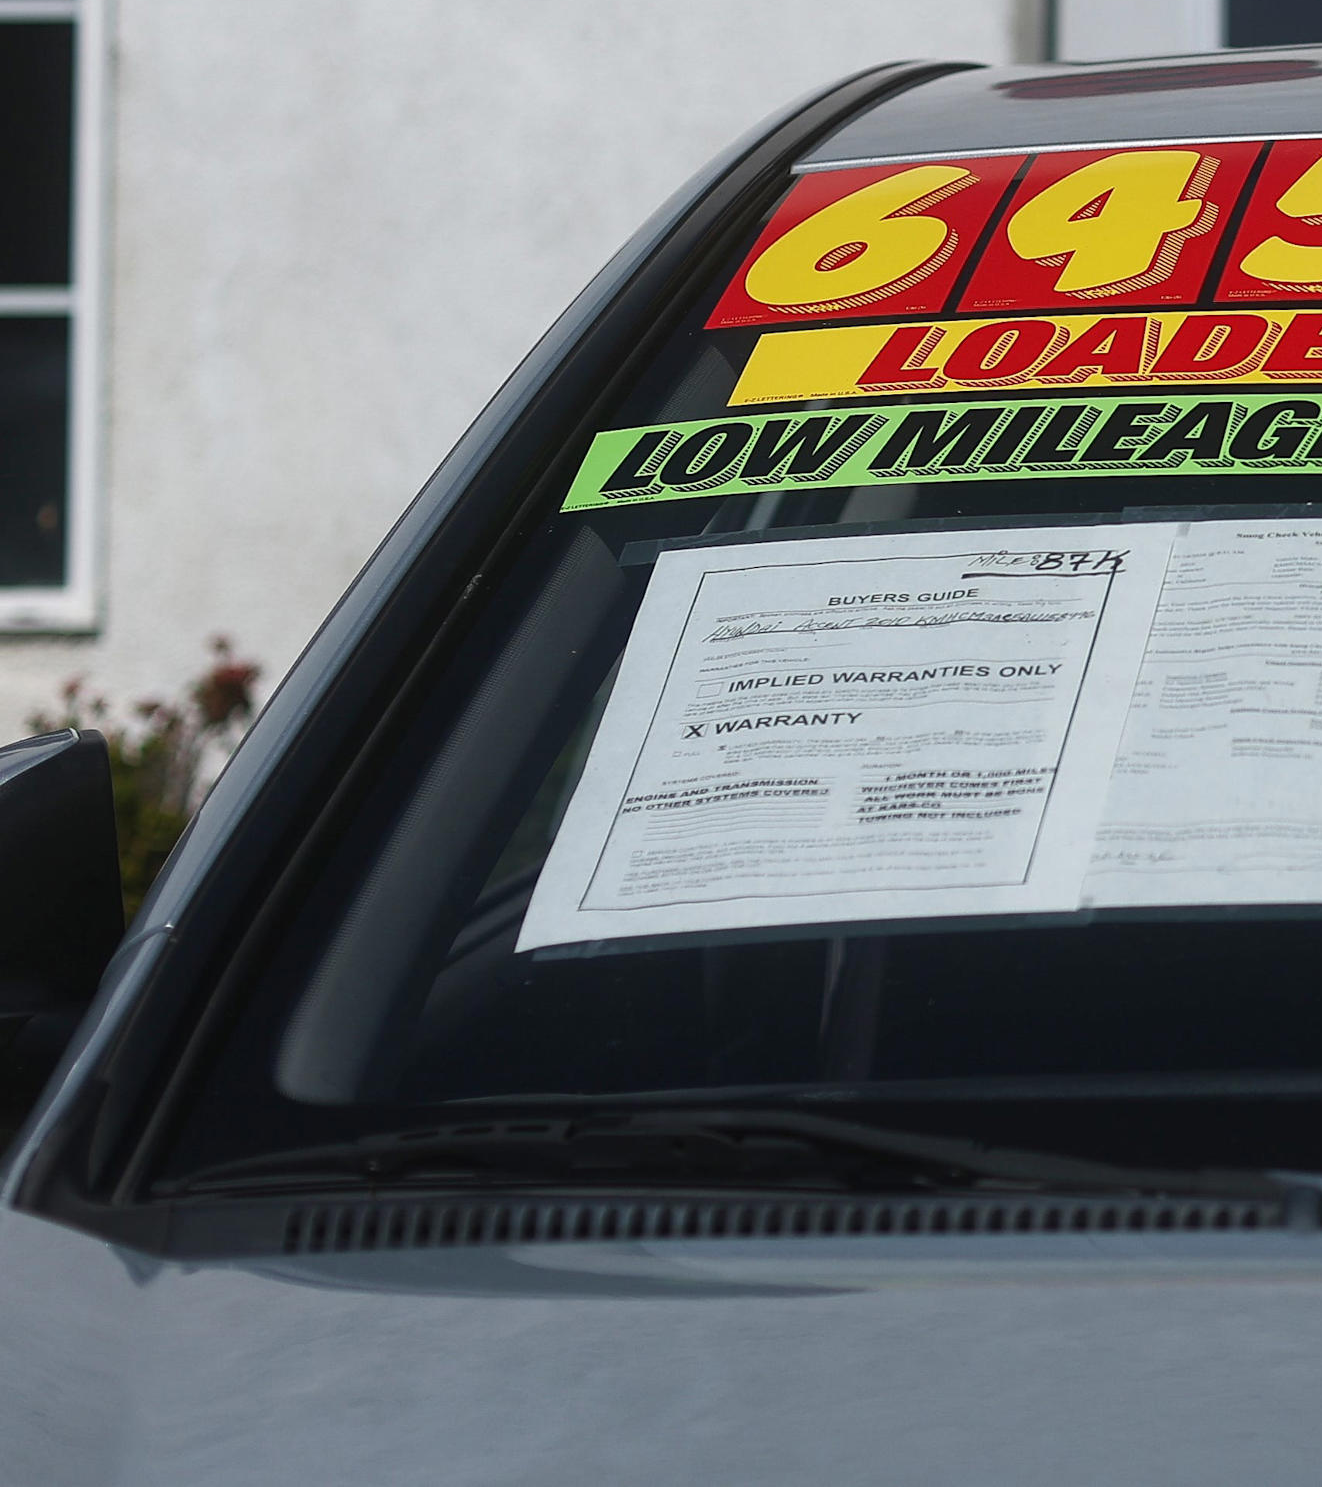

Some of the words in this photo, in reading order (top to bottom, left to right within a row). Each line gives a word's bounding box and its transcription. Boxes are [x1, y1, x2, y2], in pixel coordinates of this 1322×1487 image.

[597, 415, 888, 502] LOW
[1236, 532, 1264, 540] Smog
[1267, 530, 1298, 539] Check
[1035, 549, 1131, 572] 87K
[828, 593, 910, 606] BUYERS
[917, 588, 980, 602] GUIDE
[728, 673, 825, 693] IMPLIED
[832, 665, 991, 684] WARRANTIES
[998, 664, 1064, 678] ONLY
[683, 724, 705, 739] X
[715, 712, 863, 735] WARRANTY
[861, 781, 945, 793] WHICHEVER
[949, 780, 999, 789] COMES
[896, 771, 946, 781] MONTH
[622, 805, 642, 814] NO
[646, 800, 691, 811] OTHER
[694, 790, 760, 804] SYSTEMS
[763, 788, 830, 797] COVERED
[625, 792, 676, 804] ENGINE
[680, 788, 709, 798] AND
[715, 779, 819, 793] TRANSMISSION
[917, 811, 947, 819] NOT
[951, 808, 1022, 819] INCLUDED
